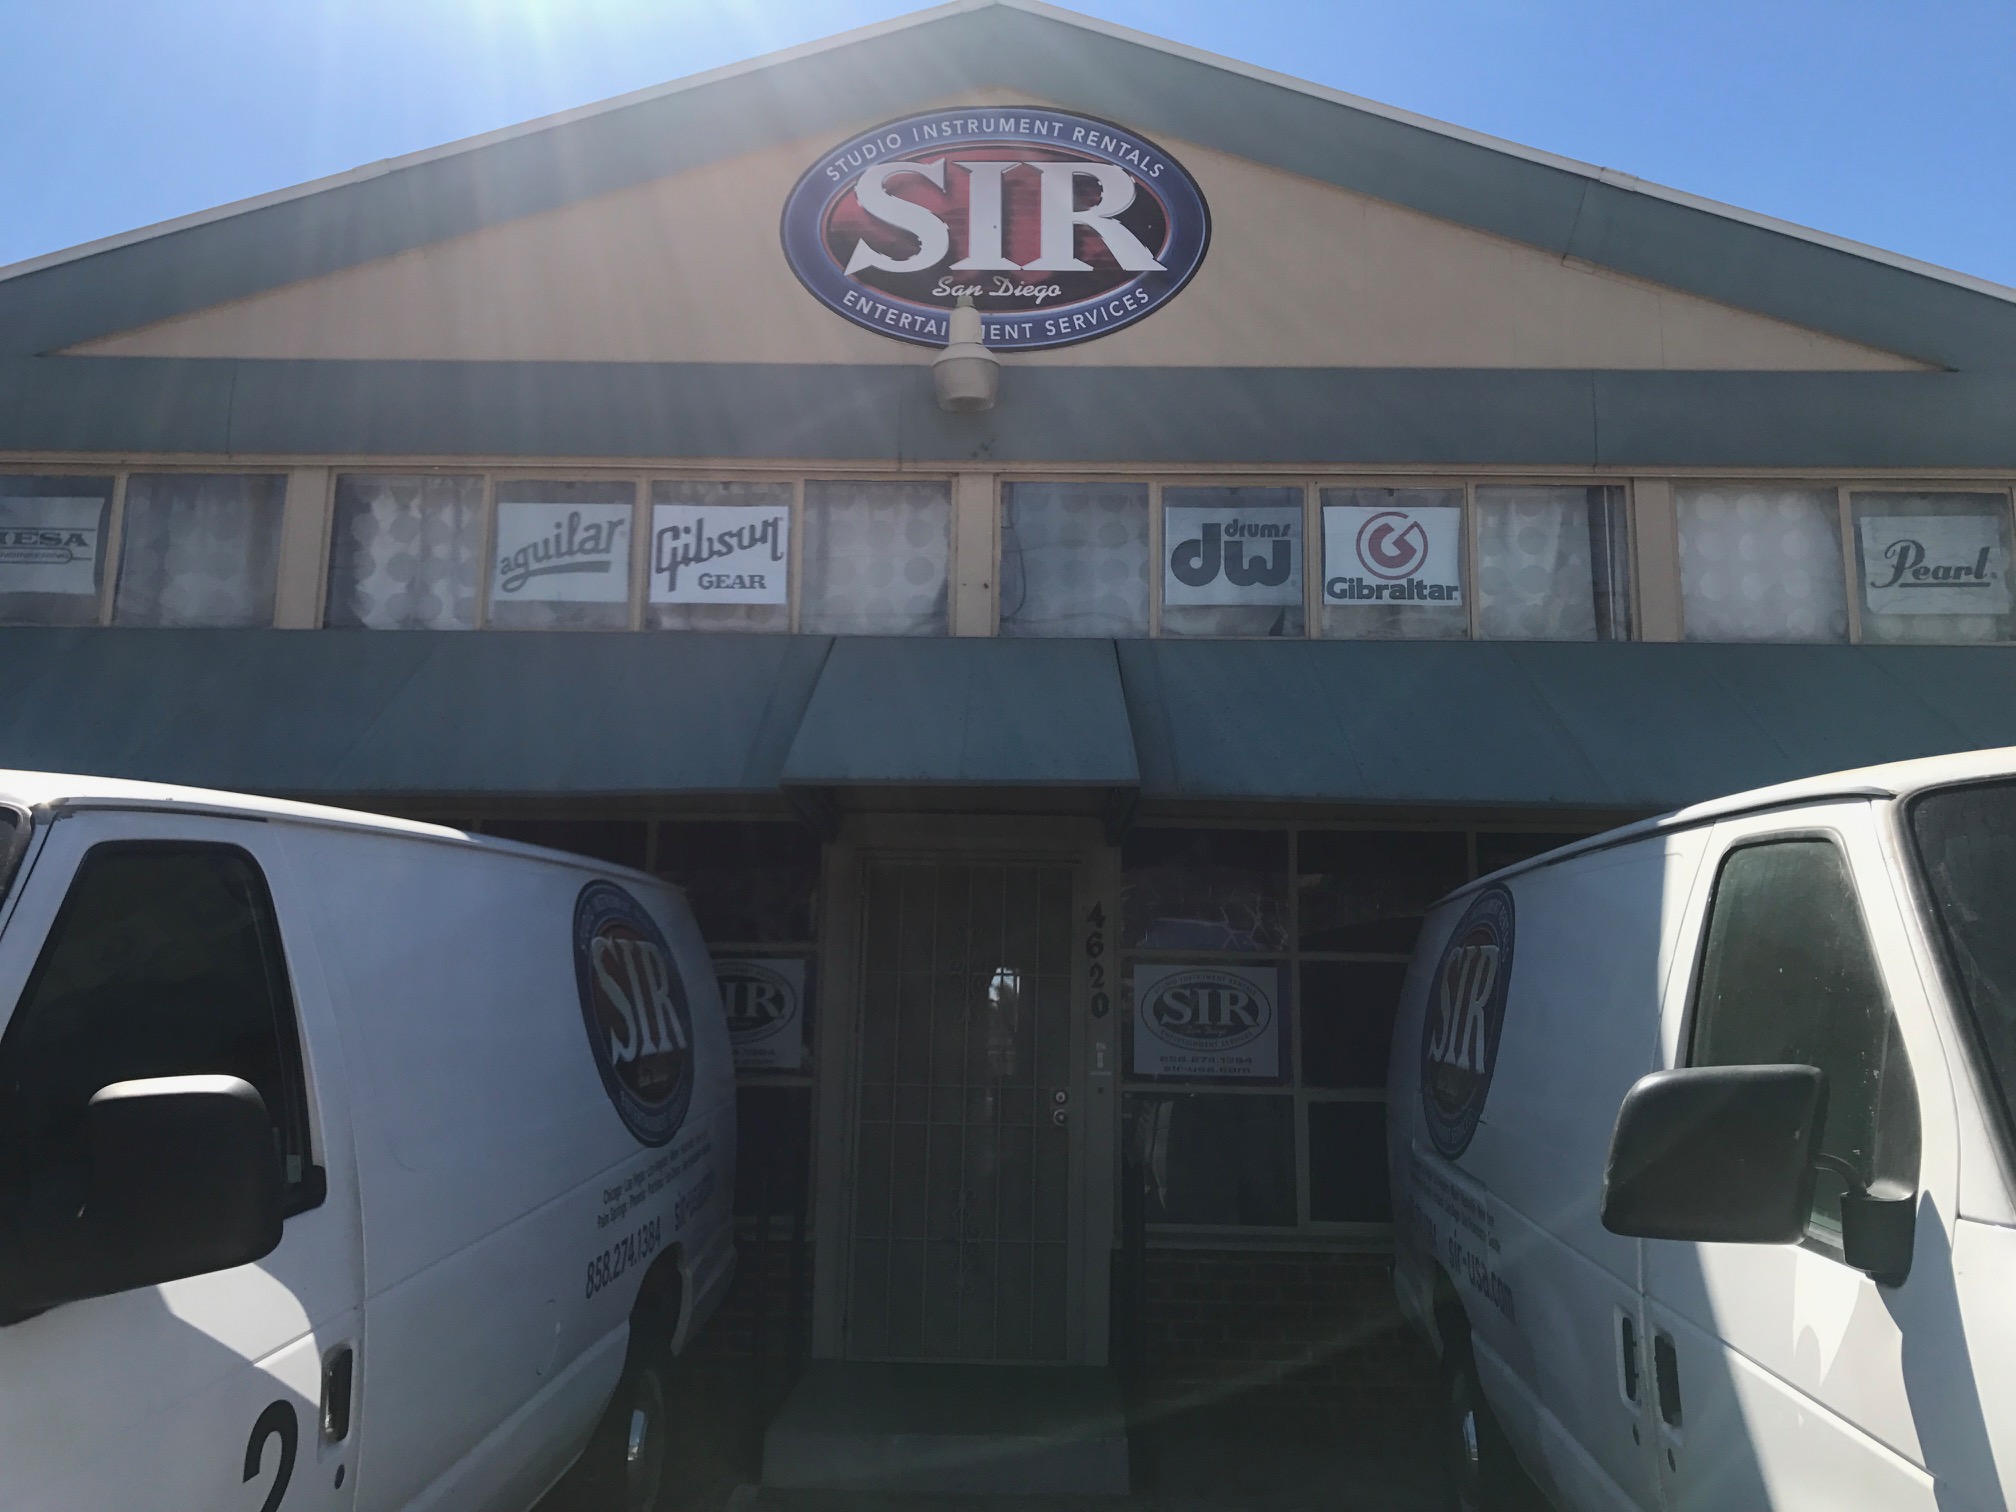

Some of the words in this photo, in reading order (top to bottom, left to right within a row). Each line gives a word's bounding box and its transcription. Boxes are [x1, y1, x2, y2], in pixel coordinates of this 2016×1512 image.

[826, 133, 902, 183] STUDIO
[913, 117, 1064, 142] INSTRUMENT
[1072, 127, 1165, 179] RENTALS
[844, 157, 1168, 276] SIR
[842, 289, 1032, 341] ENTERTAIENT
[1045, 288, 1149, 337] SERVICES
[932, 276, 983, 299] San
[988, 277, 1062, 304] Diego
[501, 511, 625, 593] aguilar
[656, 517, 783, 592] Gibson
[1224, 519, 1291, 538] drums
[698, 572, 767, 590] GEAR
[1326, 577, 1458, 601] Gibraltar
[1870, 539, 1991, 589] Pearl
[1086, 902, 1110, 1019] 4620
[591, 936, 688, 1066] SIR
[722, 980, 785, 1019] IR
[1159, 988, 1259, 1026] SIR
[1427, 944, 1499, 1075] SIR
[585, 1215, 662, 1299] 858.274.1384
[243, 1399, 299, 1512] 2
